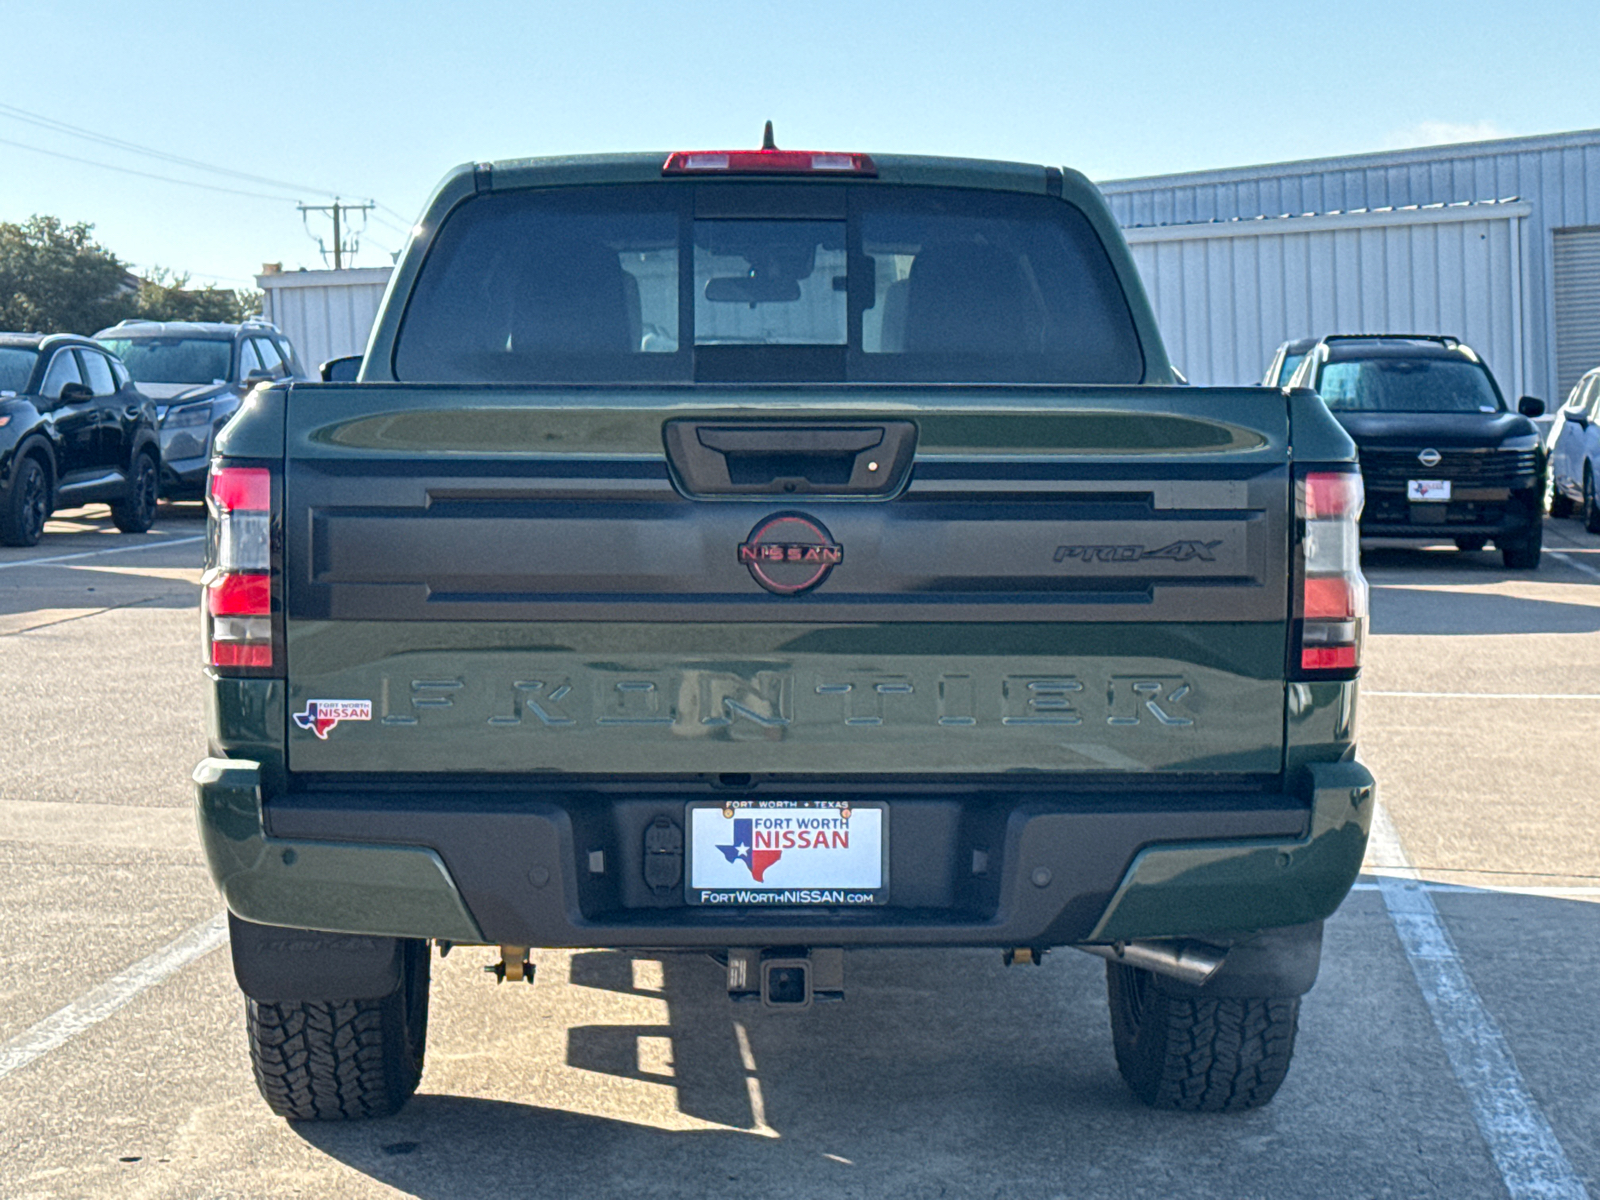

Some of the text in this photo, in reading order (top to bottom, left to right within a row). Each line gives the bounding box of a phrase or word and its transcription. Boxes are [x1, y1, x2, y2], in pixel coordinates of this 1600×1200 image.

[741, 546, 840, 560] NISSAN
[380, 676, 1195, 726] FRONTIER
[319, 709, 369, 717] NISSAN
[755, 818, 849, 829] FORT WORTH
[755, 830, 849, 849] NISSAN
